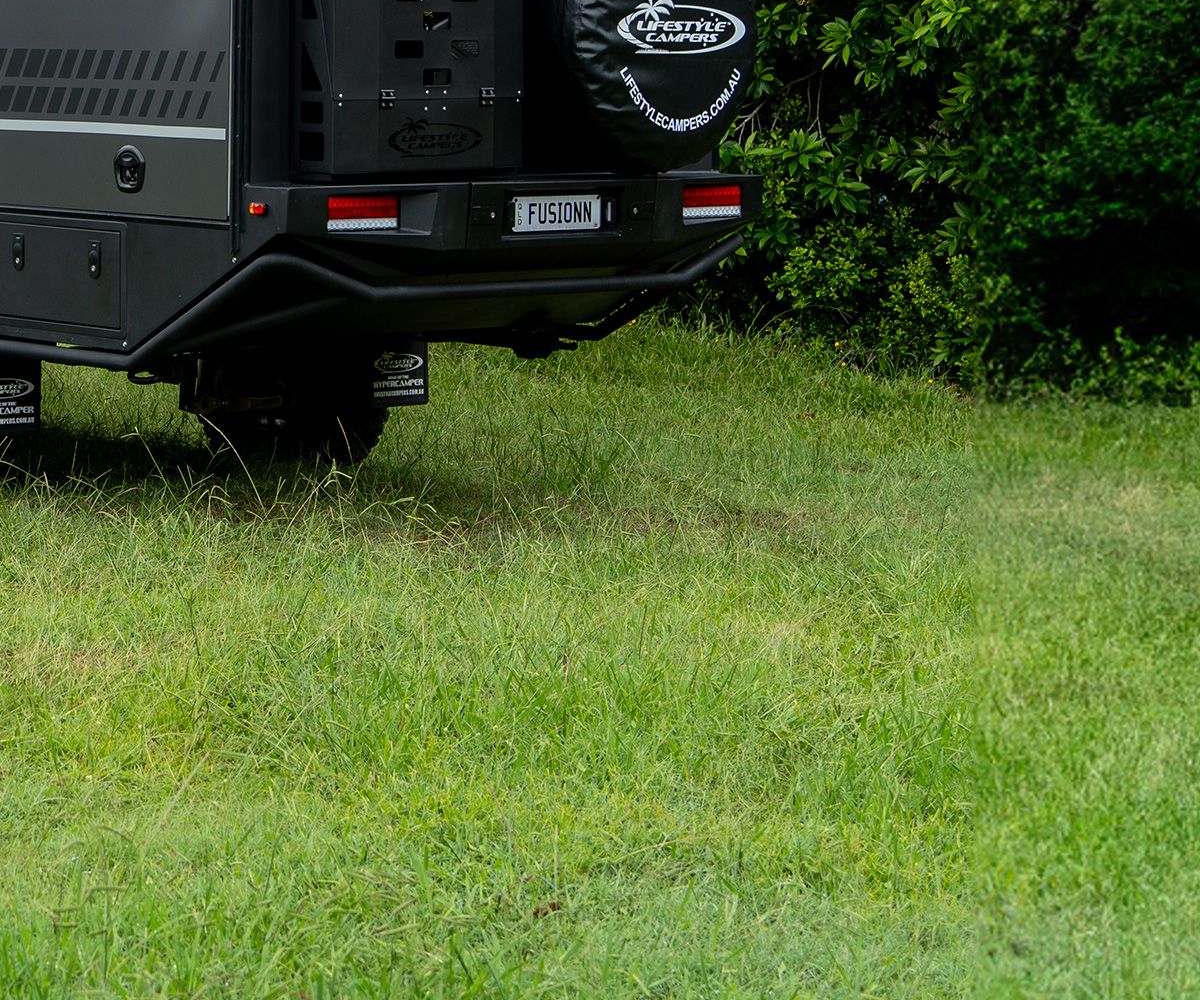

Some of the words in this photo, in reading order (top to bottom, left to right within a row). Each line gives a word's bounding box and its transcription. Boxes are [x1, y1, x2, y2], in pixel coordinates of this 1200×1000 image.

[636, 20, 727, 32] LIFESTYLE
[645, 32, 719, 43] CAMPERS
[620, 66, 741, 132] LIFESTYLECAMPERS.COM.AU
[528, 201, 592, 225] FUSIONN
